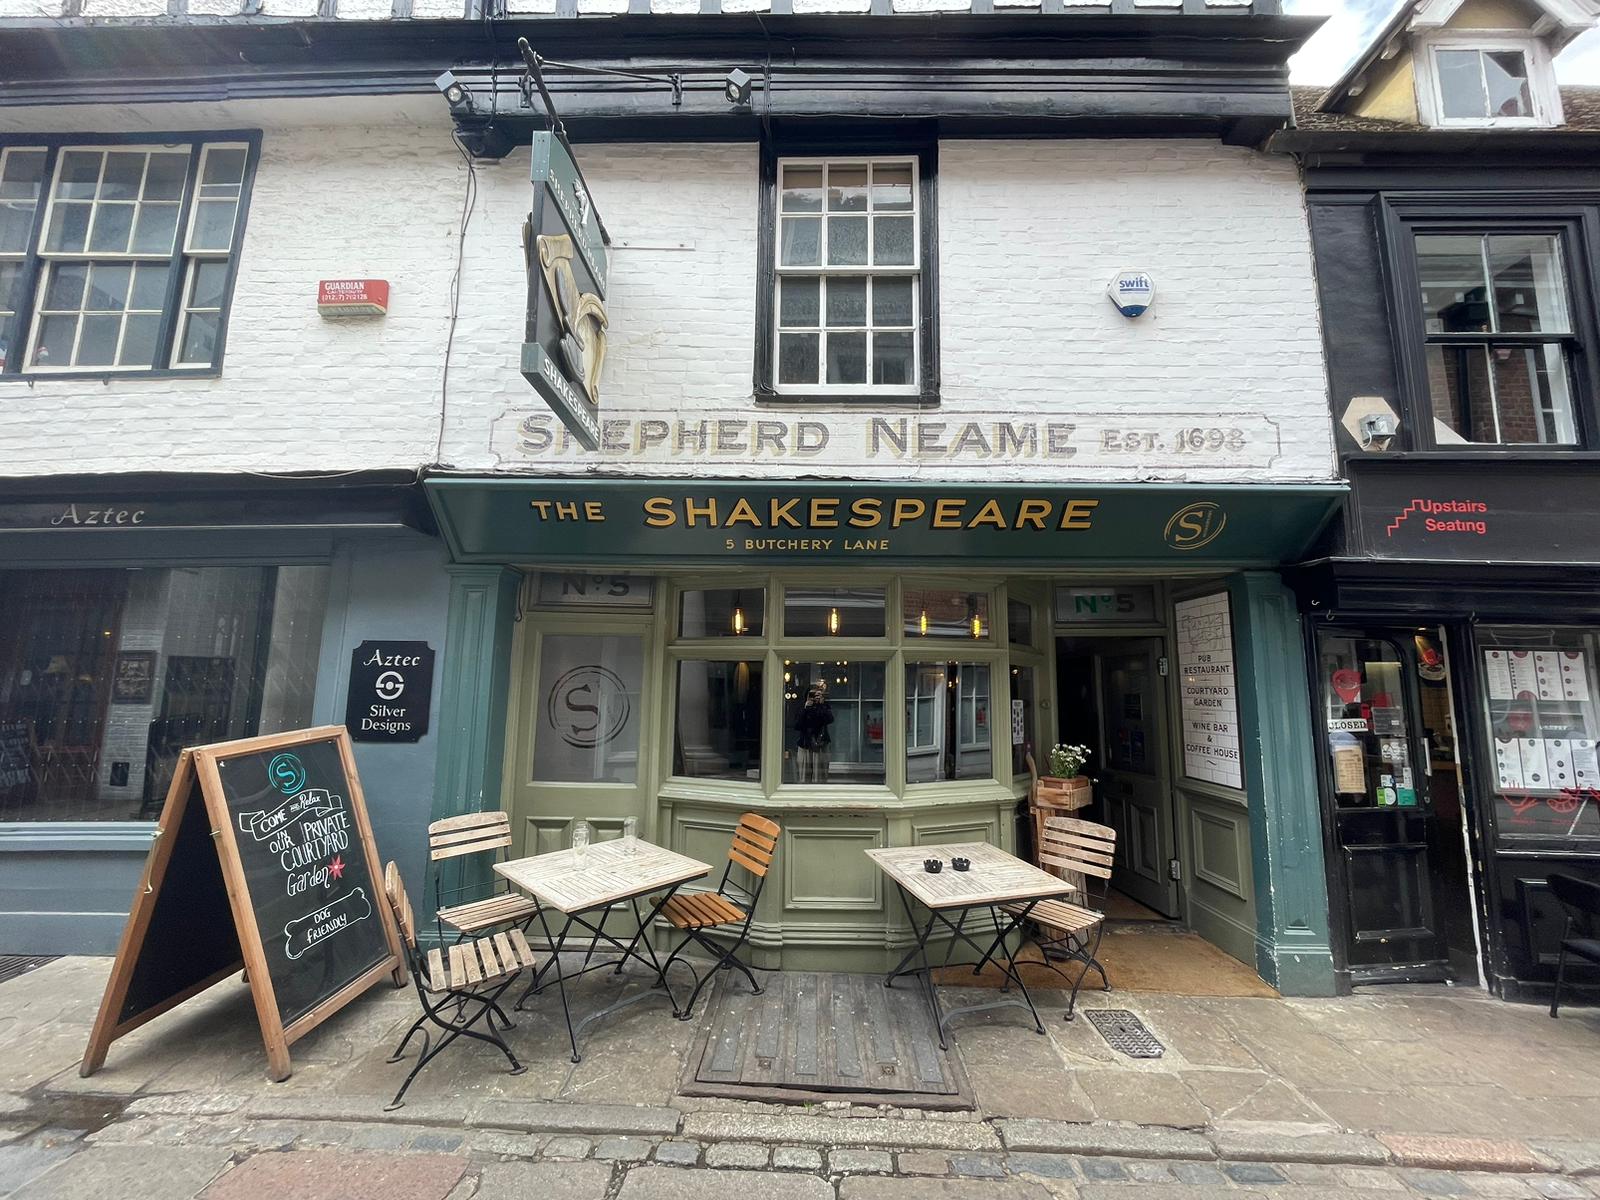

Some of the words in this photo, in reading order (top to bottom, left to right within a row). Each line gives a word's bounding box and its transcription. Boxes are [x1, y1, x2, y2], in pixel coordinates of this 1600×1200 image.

[324, 282, 365, 290] GUARDIAN
[1119, 276, 1150, 288] swift
[544, 358, 600, 442] SHAKESPEARE
[867, 416, 1077, 459] NEAME
[1101, 428, 1165, 454] EST.
[50, 503, 145, 525] Aztec
[531, 500, 606, 522] THE
[643, 497, 1099, 531] SHAKESPEARE
[1420, 499, 1488, 515] Upstairs
[725, 539, 735, 551] 5
[744, 539, 833, 551] BUTCHERY
[844, 539, 890, 551] LANE
[363, 649, 420, 667] Aztec
[1198, 654, 1211, 662] PUB
[1184, 665, 1230, 674] RESTAURANT
[1187, 687, 1229, 695] COURTYARD
[370, 704, 406, 717] Silver
[1194, 699, 1222, 707] GARDEN
[361, 718, 411, 734] Designs
[1192, 721, 1211, 731] WINE
[1213, 723, 1228, 732] BAR
[1328, 720, 1367, 730] CLOSED
[1186, 744, 1211, 755] COFFEE
[1214, 748, 1238, 759] HOUSE
[260, 808, 288, 833] COME
[299, 791, 321, 809] Relax
[269, 835, 295, 853] OUR
[304, 810, 351, 842] PRIVATE
[277, 829, 288, 841] IN
[280, 830, 350, 872] COURTYARD
[287, 864, 331, 896] Garden
[313, 907, 331, 924] DOG
